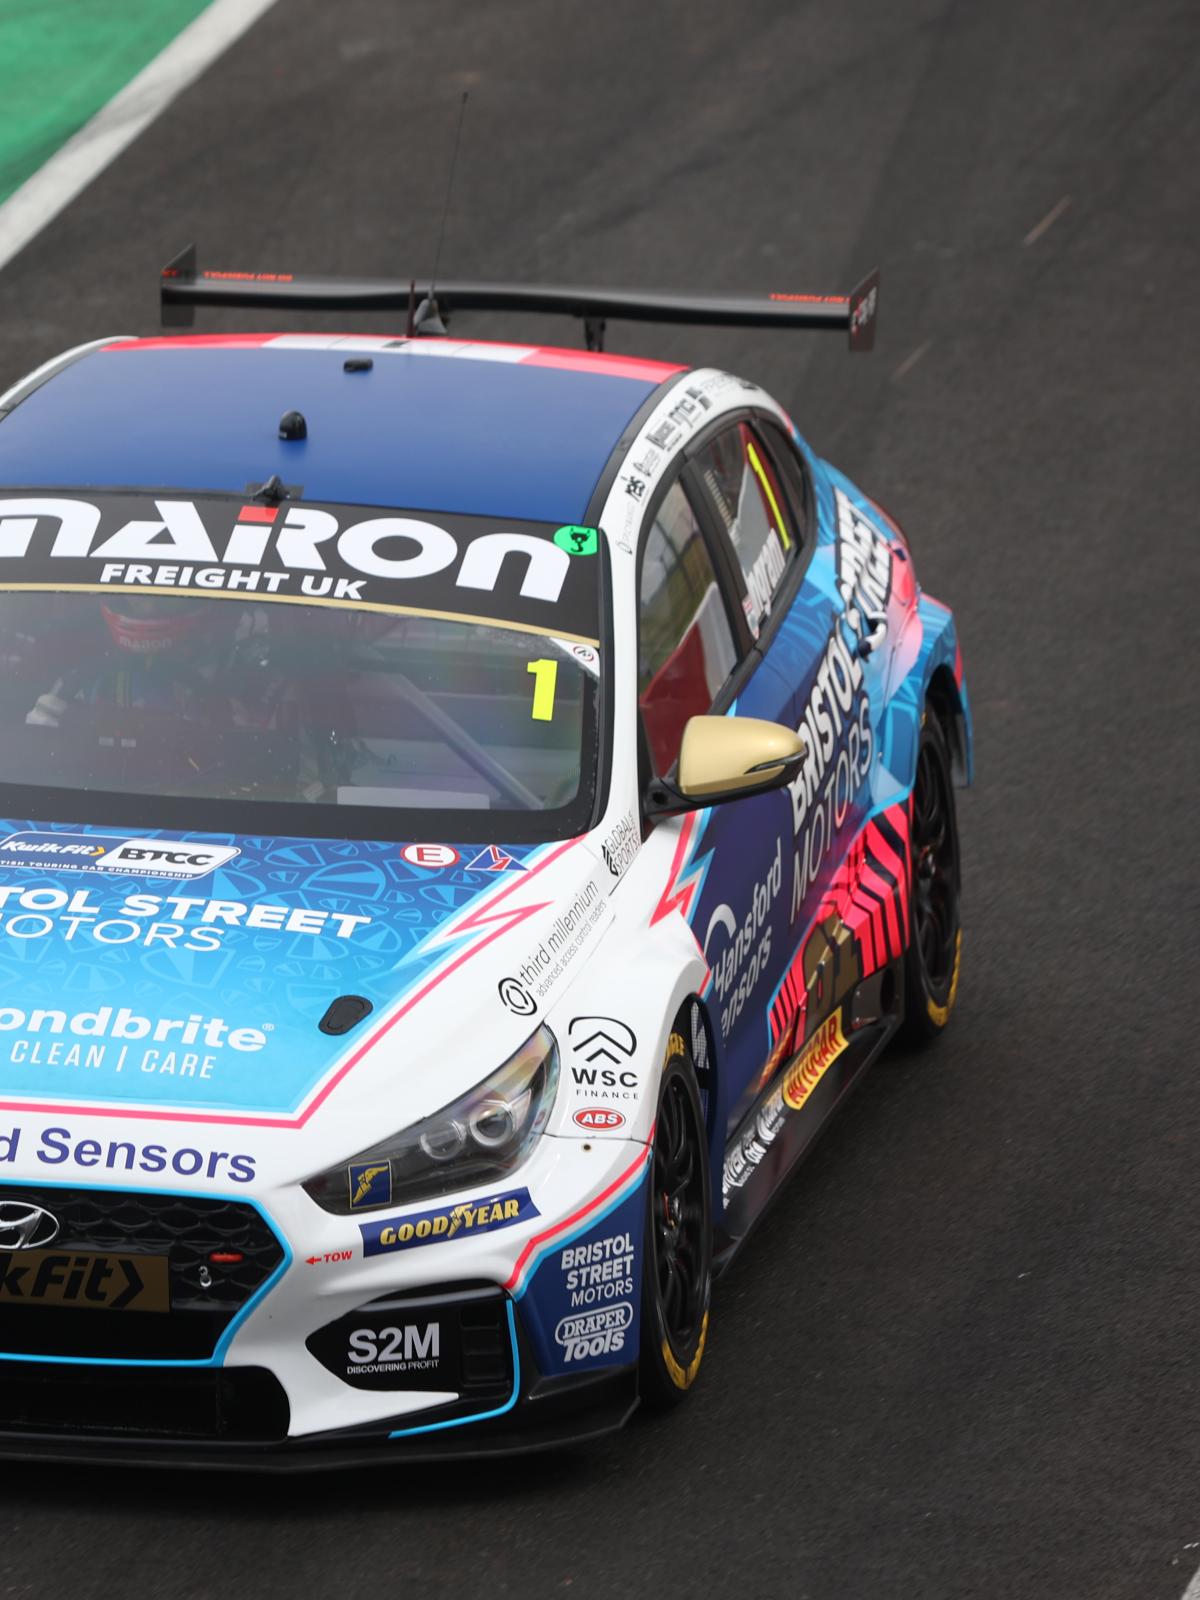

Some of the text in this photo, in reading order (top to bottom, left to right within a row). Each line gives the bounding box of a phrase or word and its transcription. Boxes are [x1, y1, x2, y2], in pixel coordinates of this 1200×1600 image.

[100, 563, 368, 600] FREIGHT UK
[527, 658, 558, 721] 1
[790, 697, 874, 925] MOTORS
[29, 862, 78, 870] TOURING
[108, 867, 193, 878] CHAMPIONSHIP
[118, 848, 212, 867] BTCC
[416, 846, 444, 863] E
[120, 894, 371, 939] STREET
[519, 880, 599, 986] third millennium
[714, 837, 782, 1002] Hansford
[721, 925, 773, 1038] ensors
[10, 1040, 105, 1069] CLEAN
[140, 1049, 216, 1080] CARE
[571, 1067, 638, 1088] WSC
[576, 1089, 639, 1100] FINANCE
[581, 1109, 619, 1126] ABS
[36, 1127, 257, 1183] Sensors
[324, 1249, 353, 1263] TOW
[561, 1232, 634, 1270] BRISTOL
[566, 1254, 634, 1290] STREET
[571, 1277, 633, 1308] MOTORS
[562, 1308, 626, 1339] DRAPER
[347, 1322, 440, 1364] S2M
[563, 1328, 625, 1363] Tools
[347, 1359, 440, 1375] DISCOVERING PROFIT
